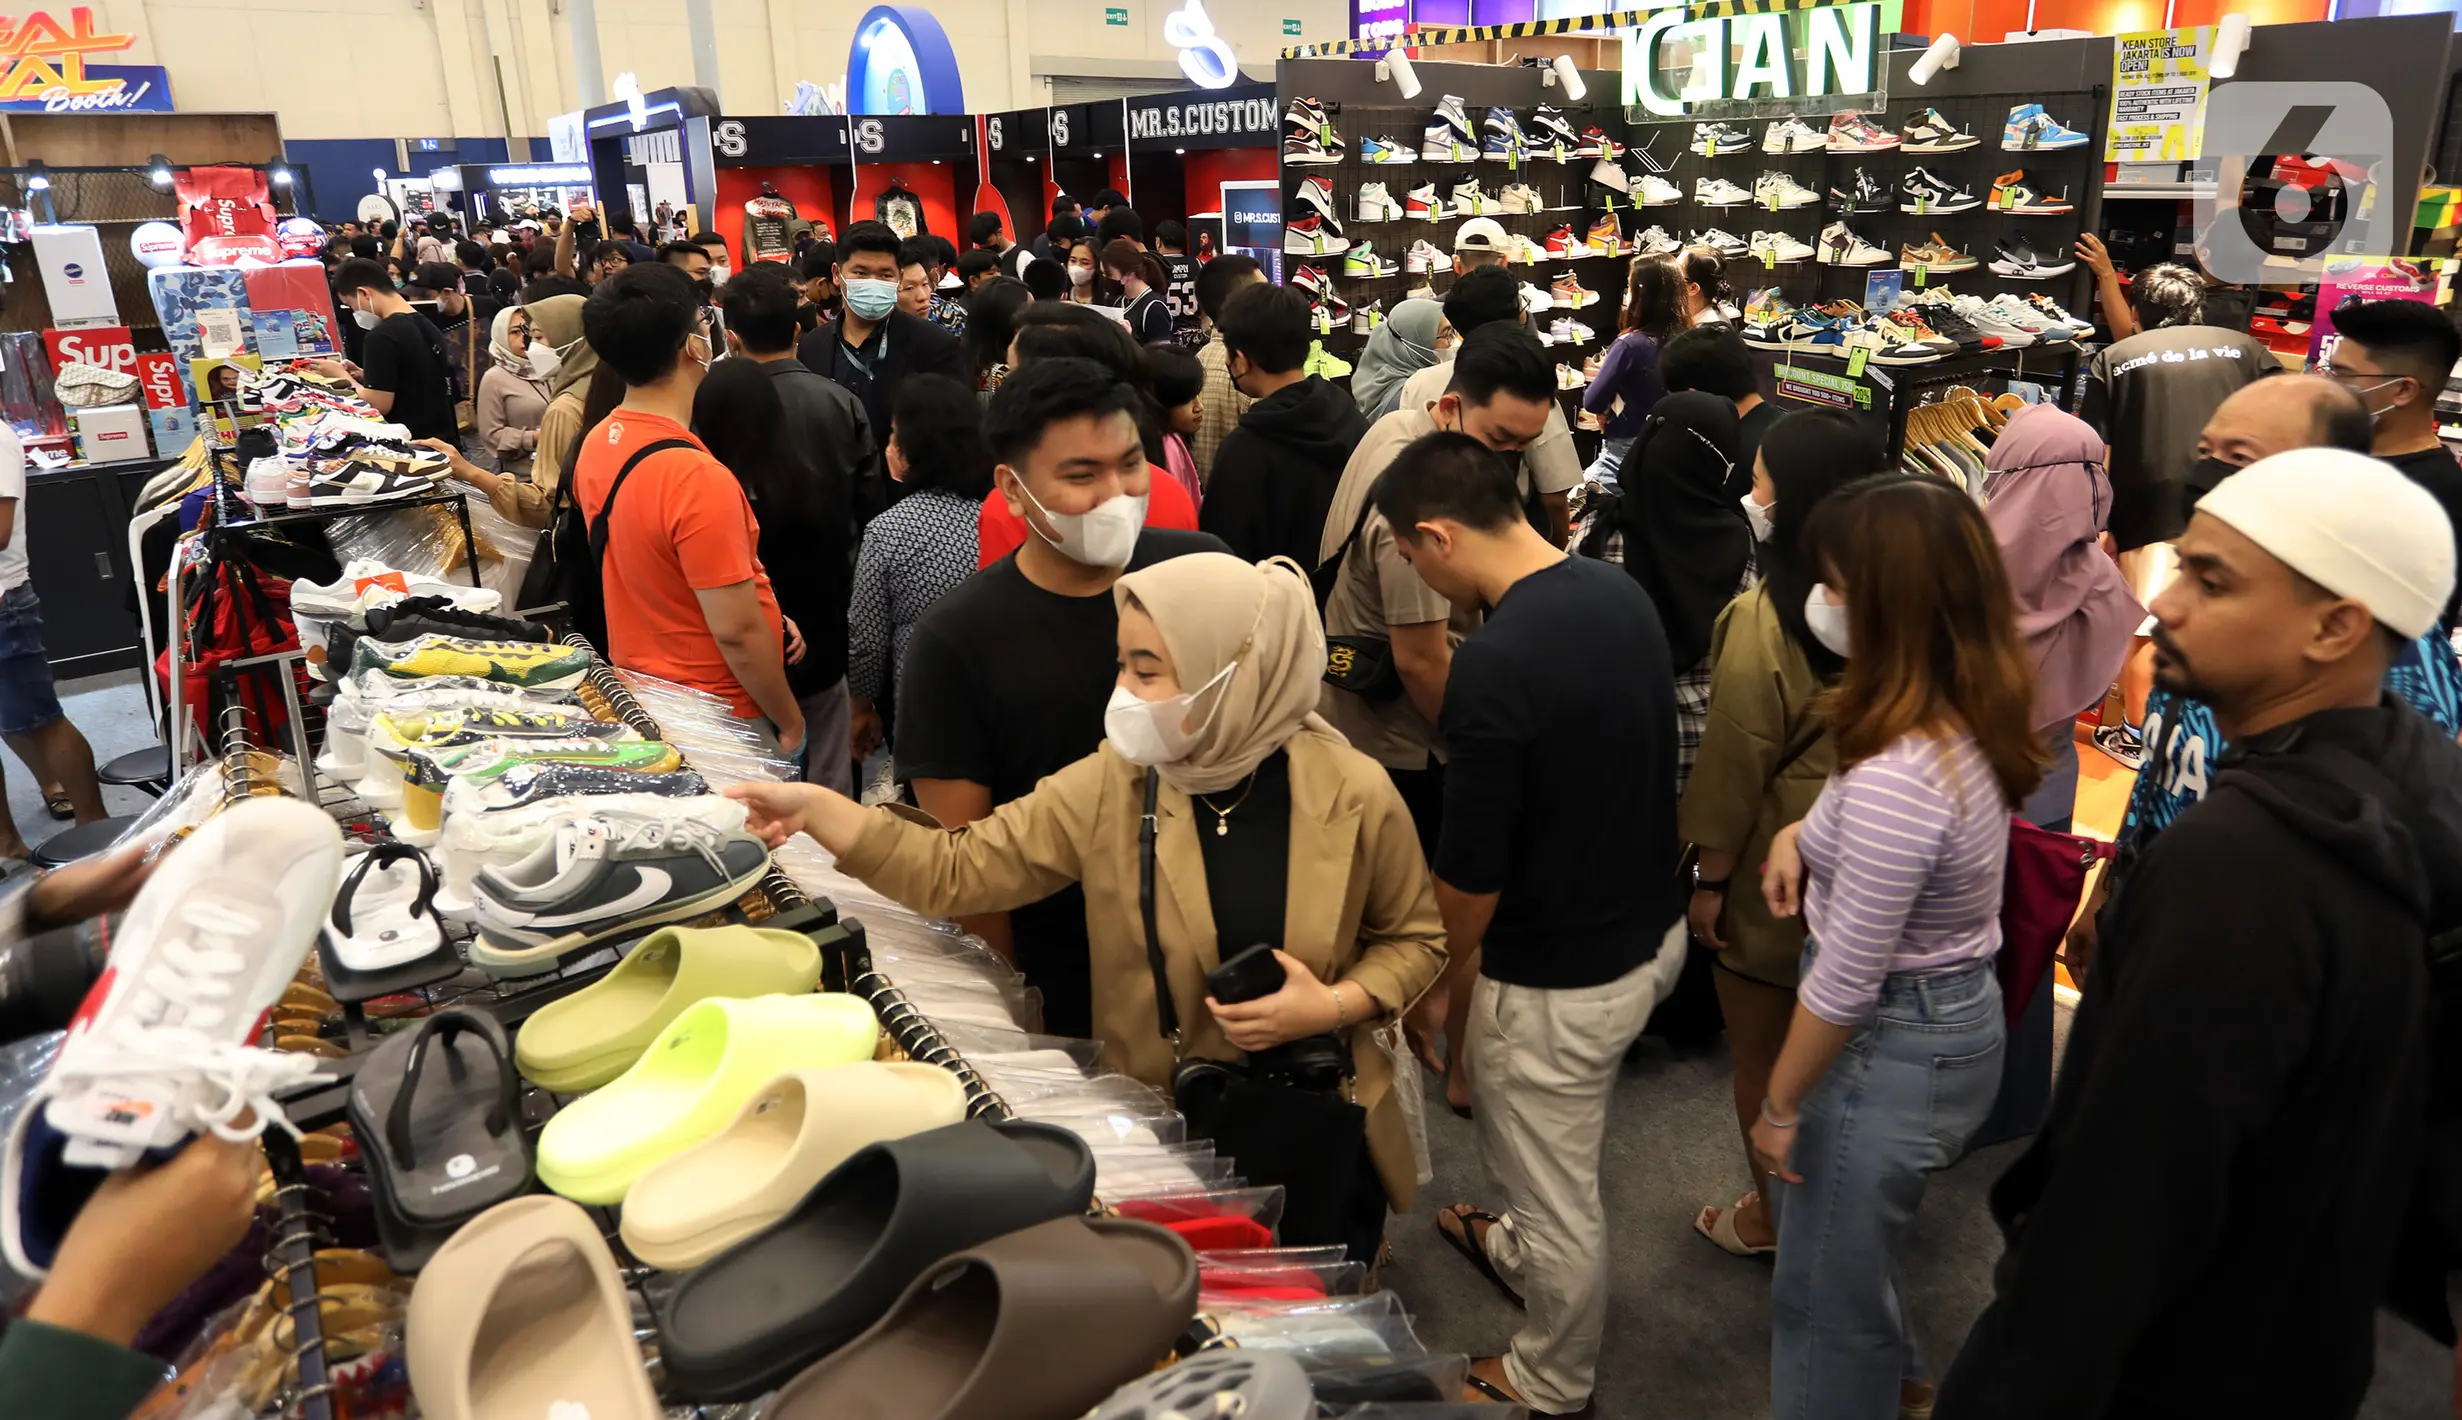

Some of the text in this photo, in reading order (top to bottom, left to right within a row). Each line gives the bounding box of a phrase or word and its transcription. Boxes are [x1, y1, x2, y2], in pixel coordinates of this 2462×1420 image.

[2122, 37, 2177, 50] KEAN STORE
[2121, 46, 2195, 61] JAKARTA IS NOW
[2121, 61, 2148, 72] OPEN!
[40, 81, 151, 112] Booth!
[2133, 98, 2159, 106] AUTHENTIC
[1130, 98, 1278, 140] MR.S.CUSTOM
[204, 242, 275, 261] Supreme
[2336, 282, 2420, 293] REVERSE CUSTOMS
[1166, 281, 1198, 317] 53
[2112, 345, 2242, 377] acmé de la vie
[1777, 365, 1811, 379] DISCOUNT
[1812, 373, 1839, 388] SPECIAL
[1855, 388, 1870, 402] 20%
[97, 432, 128, 440] Supreme
